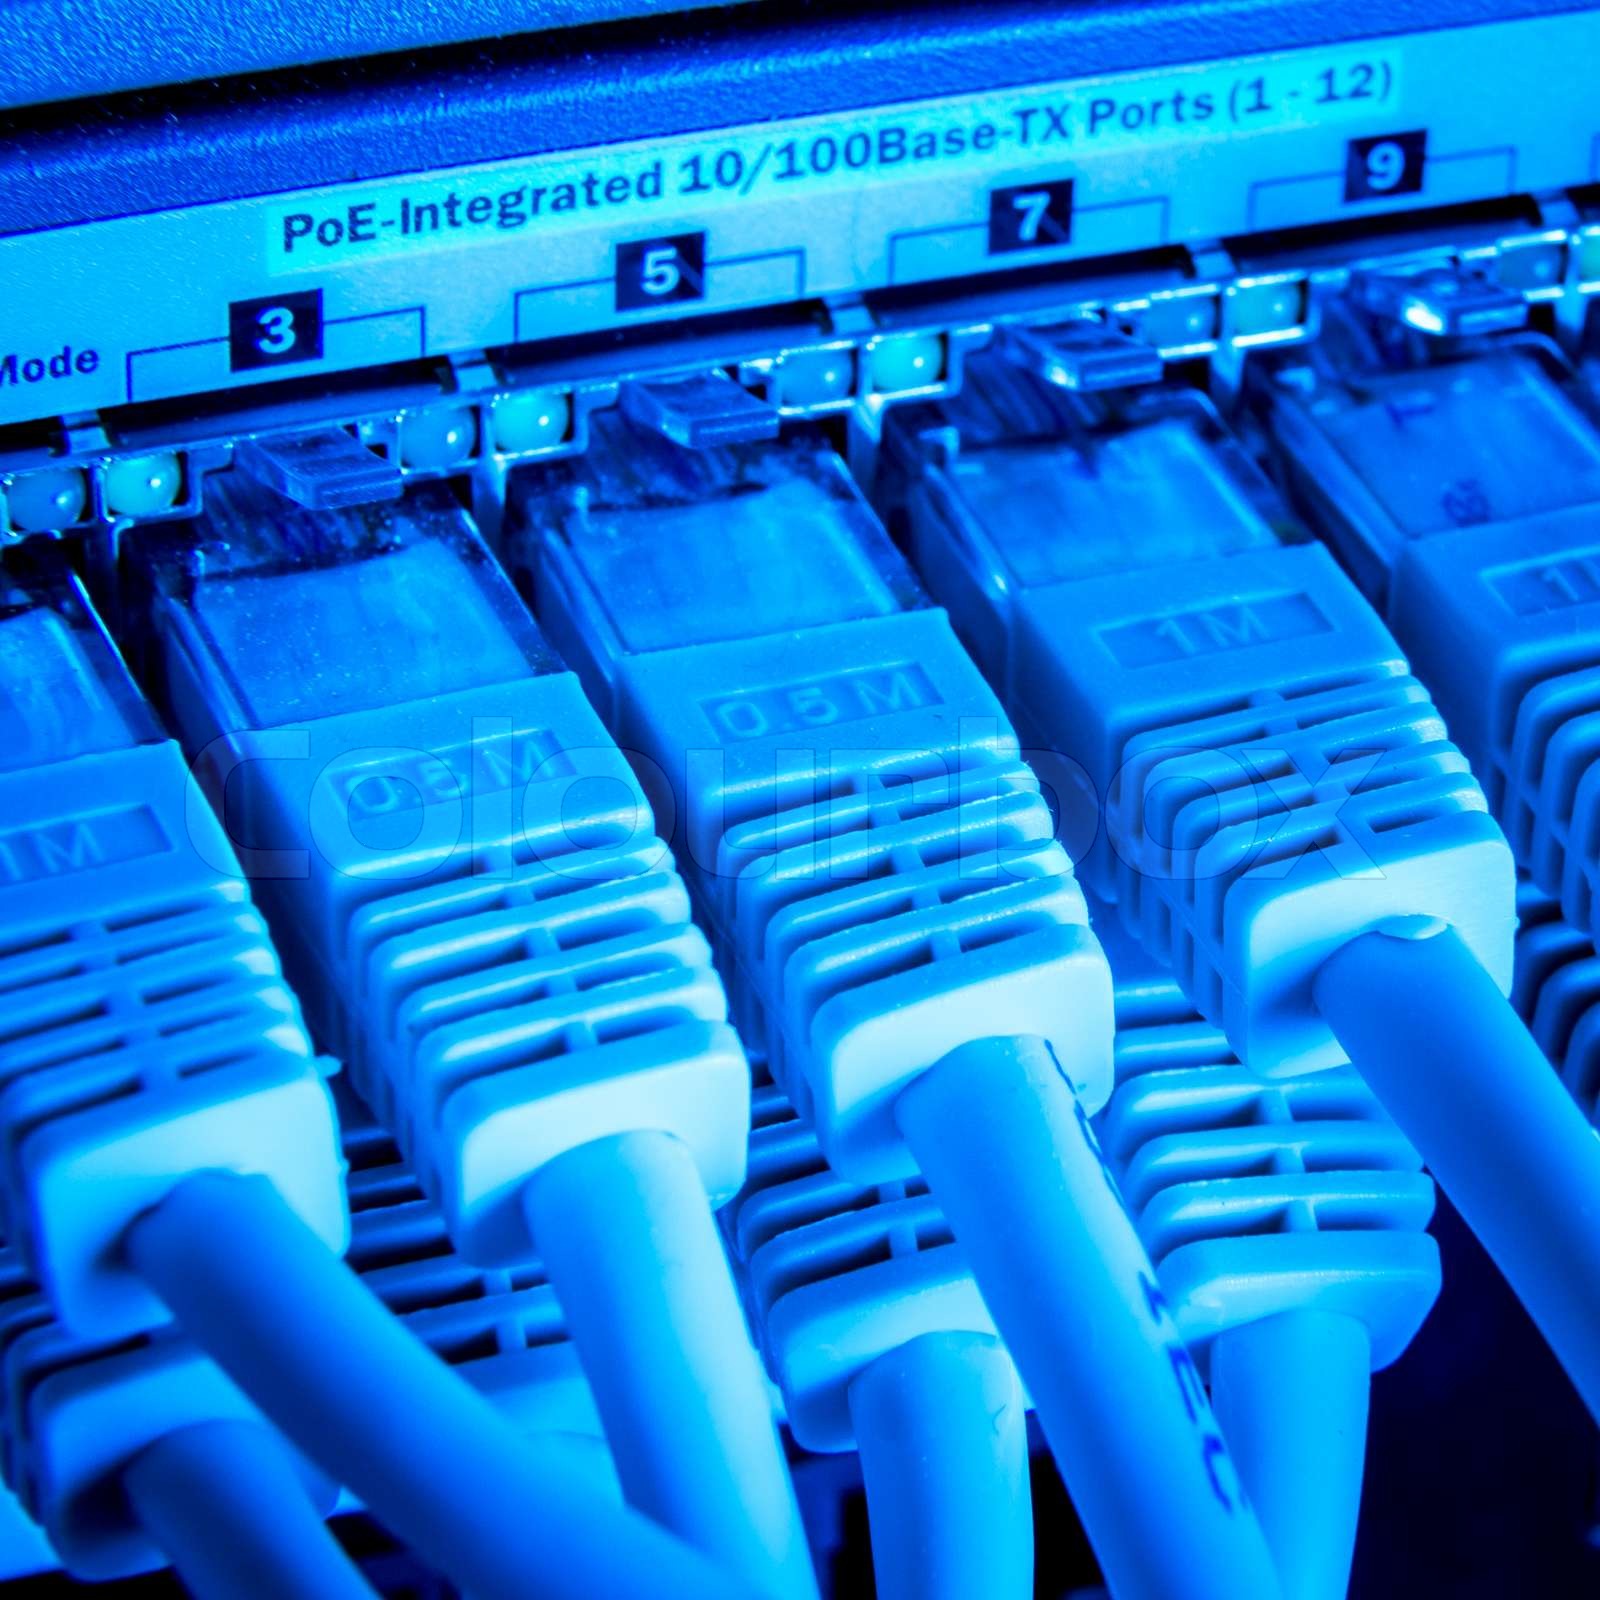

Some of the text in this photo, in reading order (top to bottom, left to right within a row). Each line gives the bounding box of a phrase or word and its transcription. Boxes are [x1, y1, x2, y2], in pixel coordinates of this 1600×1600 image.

[282, 163, 662, 253] PoE-Integrated
[679, 108, 1070, 196] 10/100Base-TX
[1088, 89, 1214, 136] Ports
[1228, 77, 1272, 122] (1
[1317, 60, 1392, 104] 12)
[1366, 140, 1406, 190] 9
[1013, 191, 1052, 241] 7
[640, 246, 681, 295] 5
[256, 306, 297, 354] 3
[1155, 605, 1272, 656] 1M
